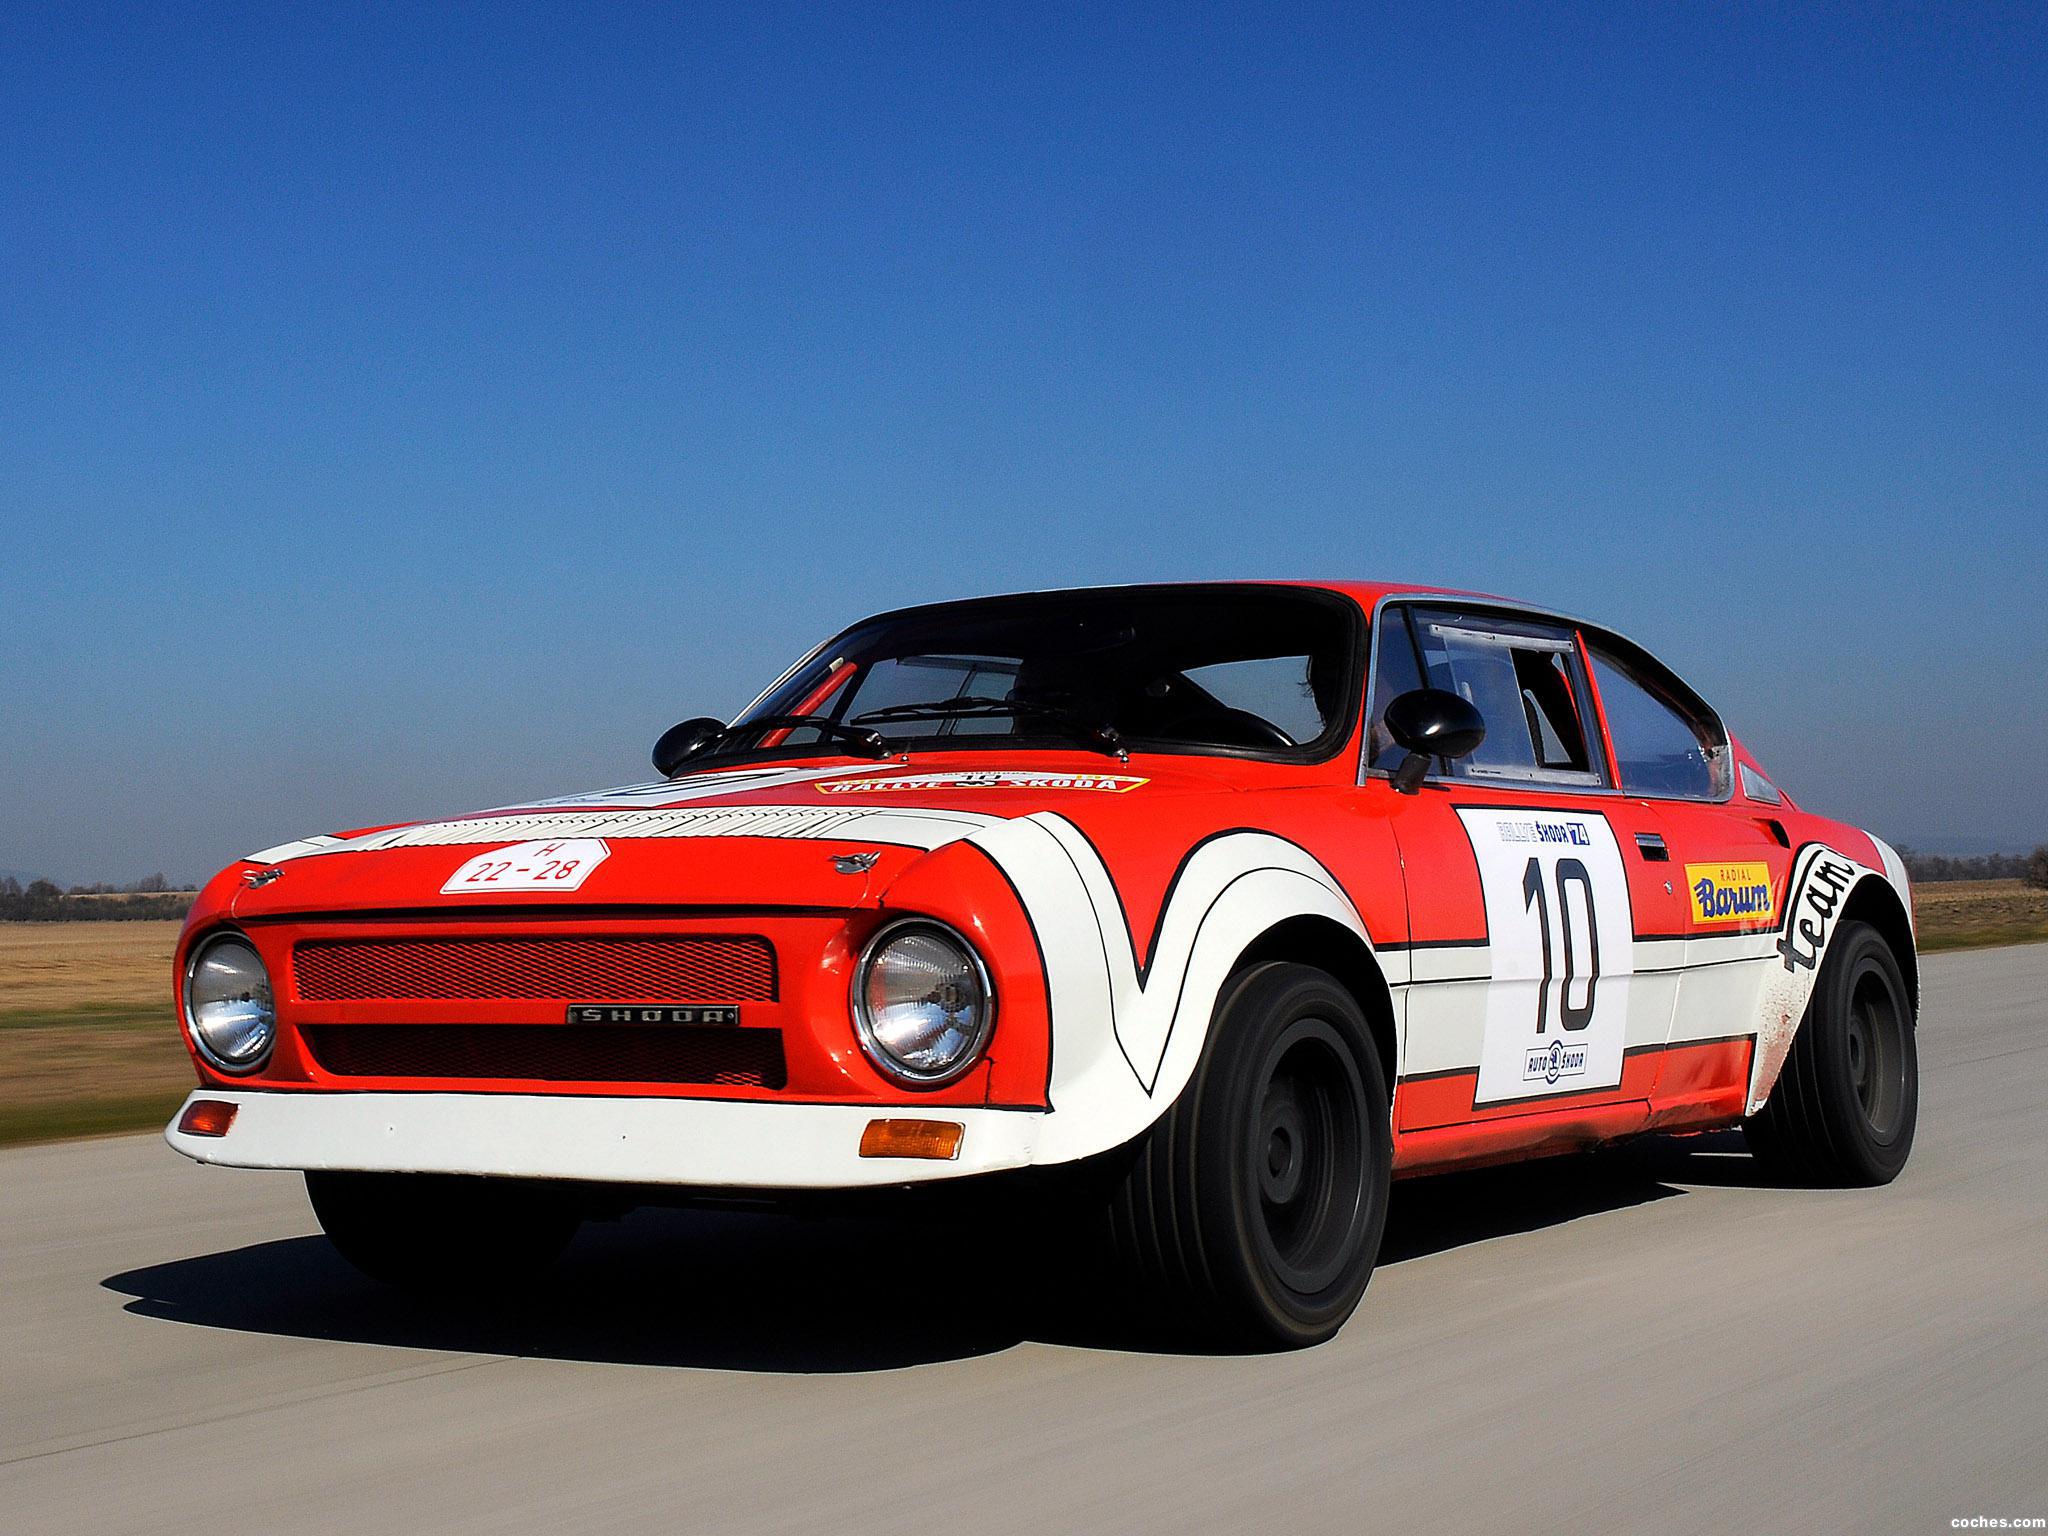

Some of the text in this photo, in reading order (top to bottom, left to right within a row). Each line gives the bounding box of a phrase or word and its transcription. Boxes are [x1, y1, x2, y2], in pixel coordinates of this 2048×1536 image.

[831, 780, 942, 793] RALLYE
[534, 843, 567, 857] H
[1720, 868, 1752, 881] RADIAL
[1693, 878, 1770, 918] Barum
[1776, 849, 1855, 974] team
[1522, 857, 1600, 1034] 10
[1528, 1056, 1548, 1072] AUTO
